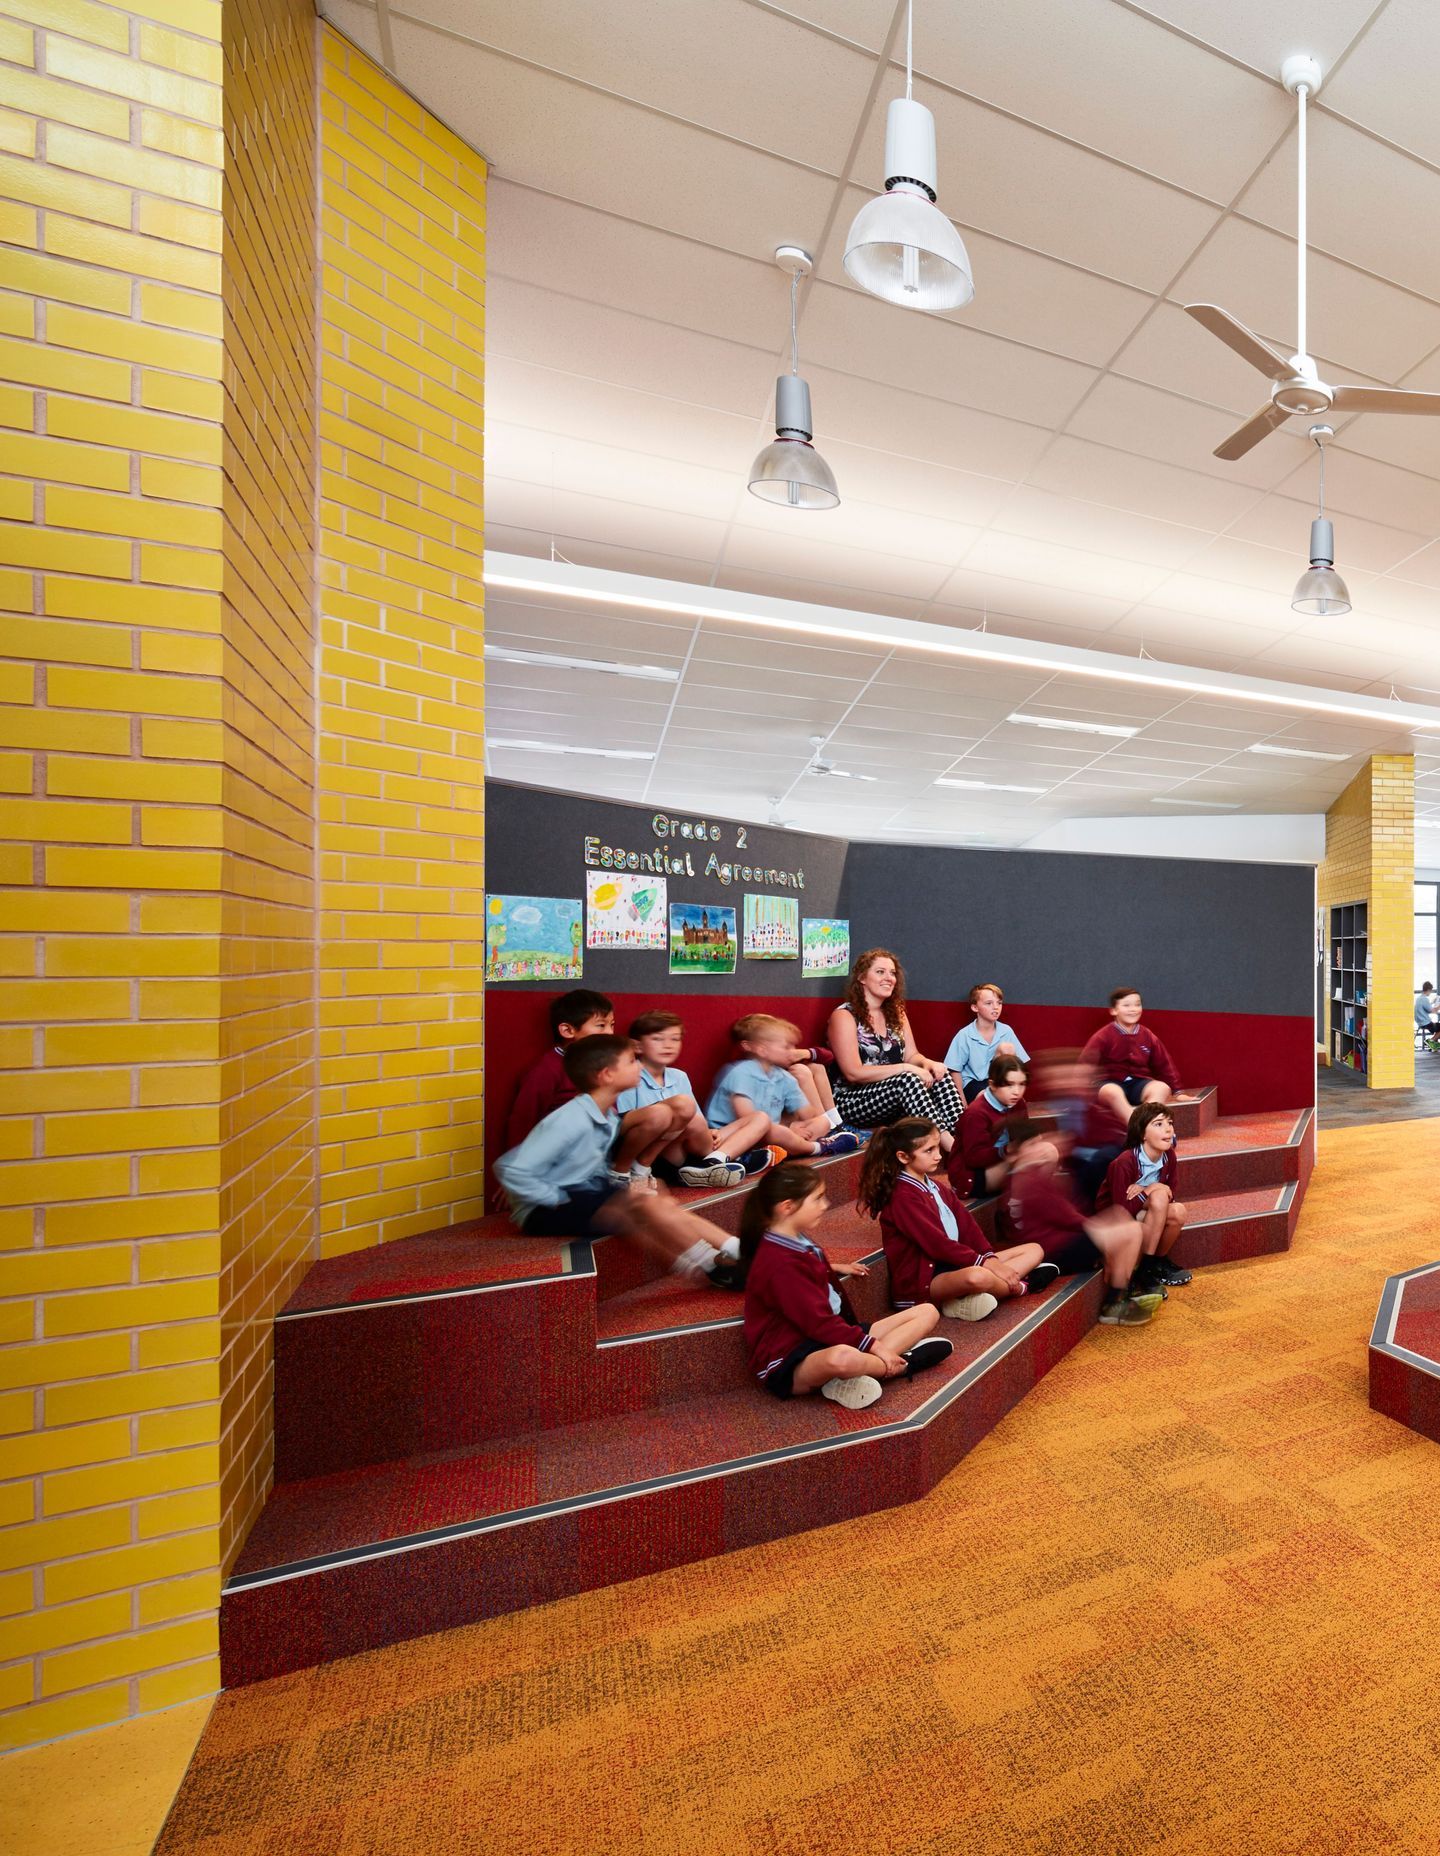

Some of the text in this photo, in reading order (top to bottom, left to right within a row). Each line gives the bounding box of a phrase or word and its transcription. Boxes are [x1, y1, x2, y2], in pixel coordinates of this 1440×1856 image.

[652, 814, 747, 849] Grade 2
[584, 836, 805, 889] Essential Agreement
